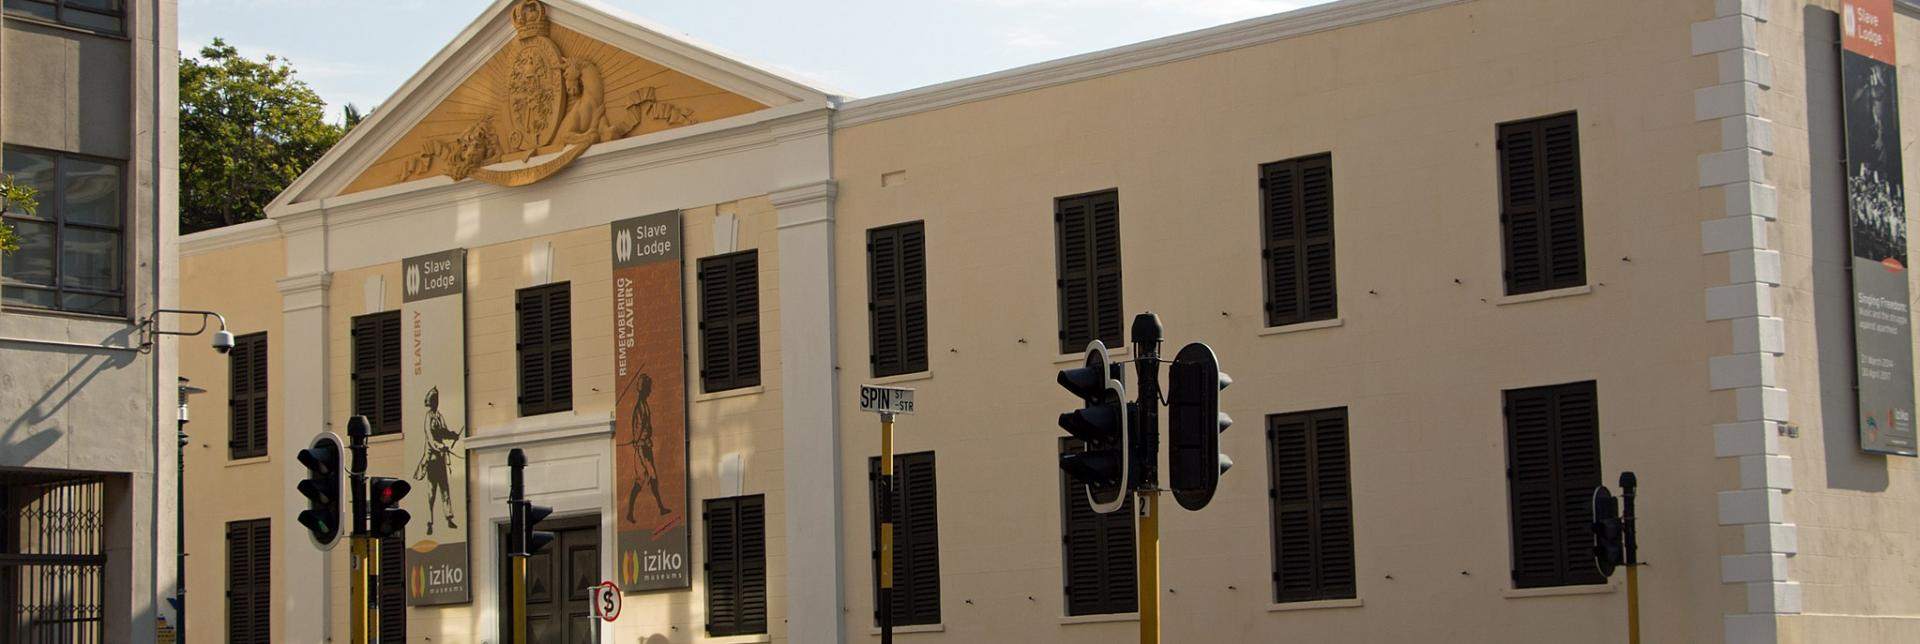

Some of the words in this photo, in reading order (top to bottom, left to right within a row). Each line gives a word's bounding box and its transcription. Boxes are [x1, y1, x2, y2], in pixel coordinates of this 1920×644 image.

[637, 224, 667, 240] Slave
[637, 240, 671, 256] Lodge
[424, 260, 451, 274] Slave
[424, 274, 455, 290] Lodge
[625, 278, 634, 348] SLAVERY
[617, 277, 626, 376] REMEMBERING
[414, 310, 422, 376] SLAVERY
[861, 386, 890, 410] SPIN
[894, 389, 904, 399] ST
[644, 549, 682, 572] iziko
[429, 564, 463, 586] iziko
